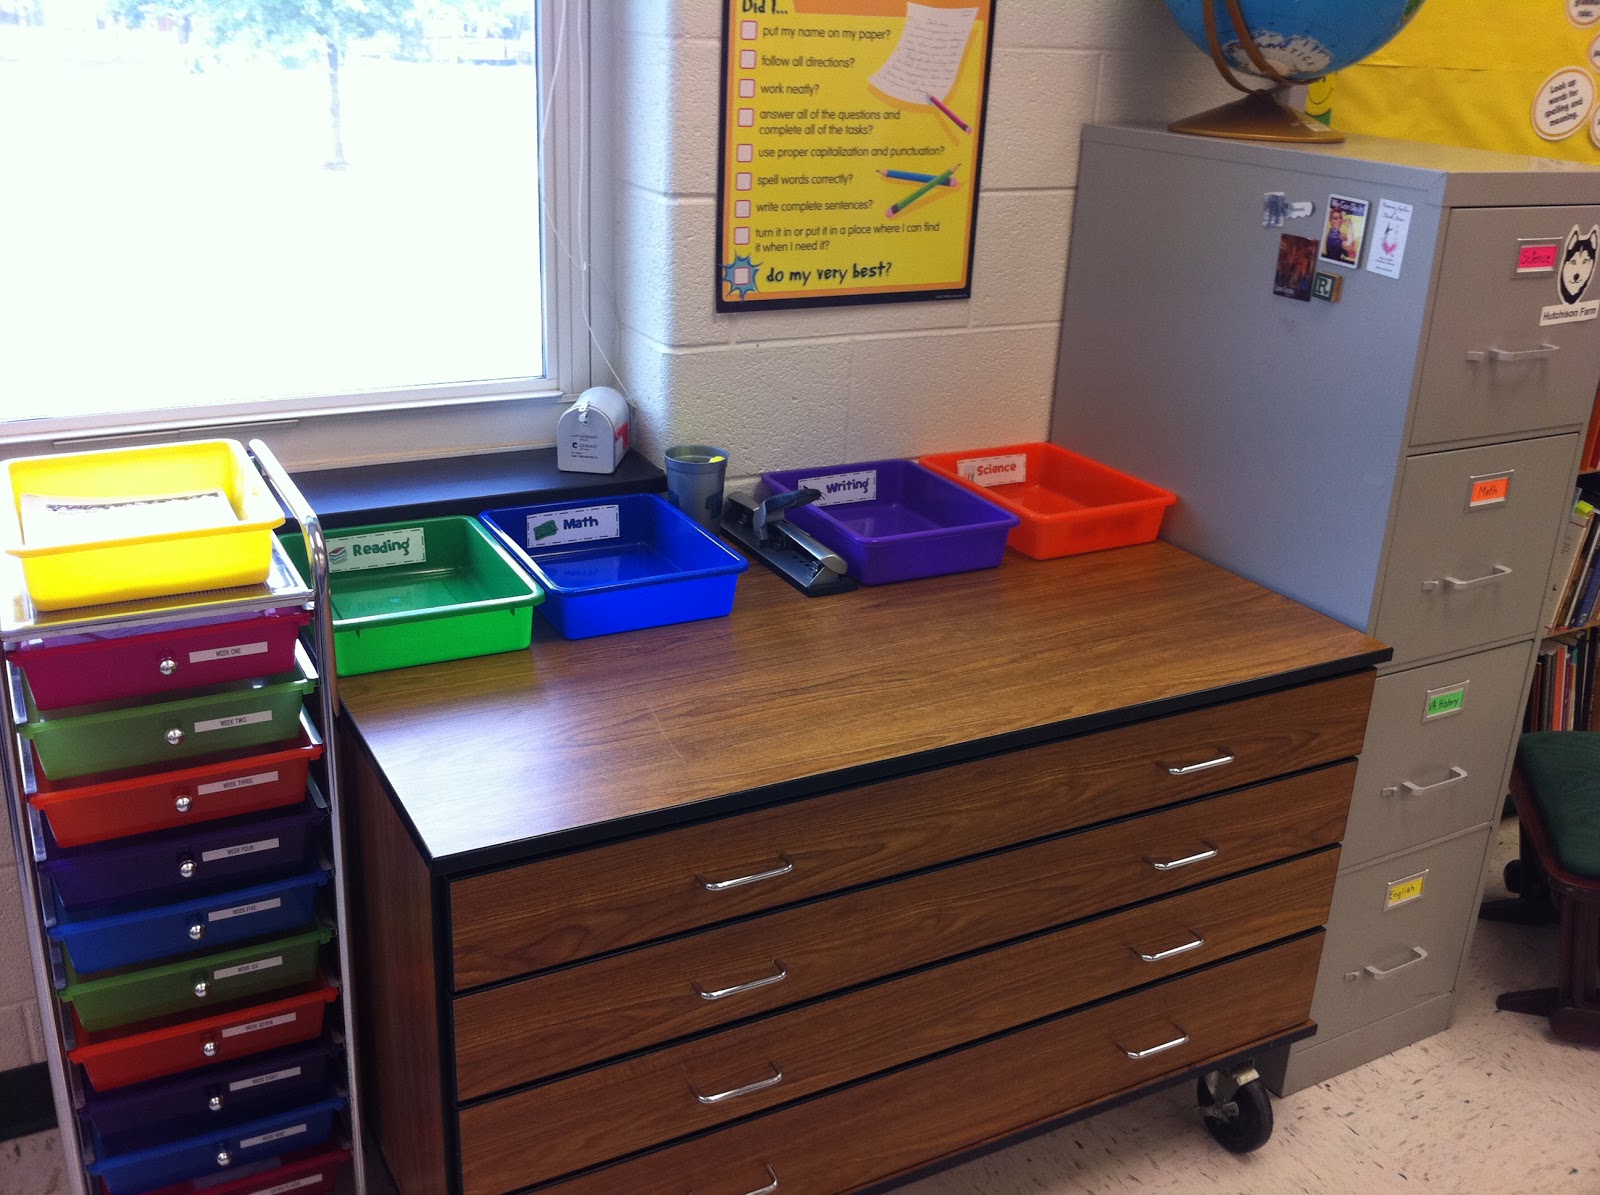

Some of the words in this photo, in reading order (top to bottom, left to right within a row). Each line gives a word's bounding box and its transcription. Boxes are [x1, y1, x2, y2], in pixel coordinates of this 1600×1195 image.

[742, 0, 765, 13] Did
[763, 27, 778, 38] put
[781, 28, 796, 39] my
[798, 28, 826, 38] name
[827, 29, 840, 38] on
[842, 30, 857, 41] my
[859, 29, 891, 41] paper?
[761, 55, 789, 67] follow
[792, 56, 803, 67] all
[806, 57, 855, 68] directions?
[761, 83, 784, 94] work
[786, 84, 819, 96] neatly?
[1550, 82, 1566, 93] Look
[1548, 93, 1567, 105] words
[1545, 104, 1569, 118] spelling
[1571, 97, 1583, 108] and
[760, 110, 795, 120] answer
[797, 109, 808, 120] all
[810, 109, 820, 120] of
[821, 109, 836, 120] the
[838, 109, 881, 121] questions
[883, 109, 901, 120] and
[759, 124, 802, 136] complete
[804, 124, 815, 135] all
[817, 124, 827, 135] of
[828, 124, 843, 135] the
[845, 124, 873, 135] tasks?
[758, 149, 775, 158] use
[777, 148, 809, 159] proper
[810, 146, 869, 158] capitalization
[871, 146, 888, 157] and
[890, 146, 945, 158] punctuation?
[757, 174, 779, 187] spell
[781, 174, 809, 185] words
[811, 173, 853, 186] correctly?
[756, 201, 779, 212] write
[781, 200, 822, 213] complete
[824, 200, 874, 211] sentences?
[756, 228, 774, 238] turn
[776, 227, 782, 238] it
[783, 228, 792, 237] in
[794, 228, 803, 237] or
[805, 226, 820, 238] put
[822, 226, 828, 236] it
[829, 226, 838, 236] in
[840, 227, 846, 235] a
[847, 225, 871, 237] place
[873, 223, 900, 233] where
[901, 223, 905, 232] I
[906, 224, 921, 233] can
[923, 222, 940, 232] find
[755, 242, 761, 252] it
[763, 242, 788, 252] when
[790, 241, 793, 251] I
[795, 240, 817, 251] need
[820, 240, 831, 251] it?
[767, 267, 784, 282] do
[789, 269, 811, 286] my
[816, 267, 848, 284] very
[852, 262, 892, 279] best?
[1316, 278, 1329, 294] R
[1543, 308, 1578, 320] Hutchison
[1579, 307, 1597, 317] Farm
[976, 461, 1018, 476] Science
[826, 477, 870, 494] Writing
[1478, 485, 1498, 497] Math
[563, 515, 599, 531] Math
[352, 535, 410, 557] Reading
[216, 648, 230, 657] WEEK
[230, 647, 242, 655] ONE
[220, 719, 233, 727] WEEK
[234, 716, 247, 725] TWO
[223, 780, 237, 789] WEEK
[238, 777, 253, 786] THREE
[227, 847, 240, 855] WEEK
[241, 844, 254, 853] FOUR
[1388, 885, 1415, 900] English
